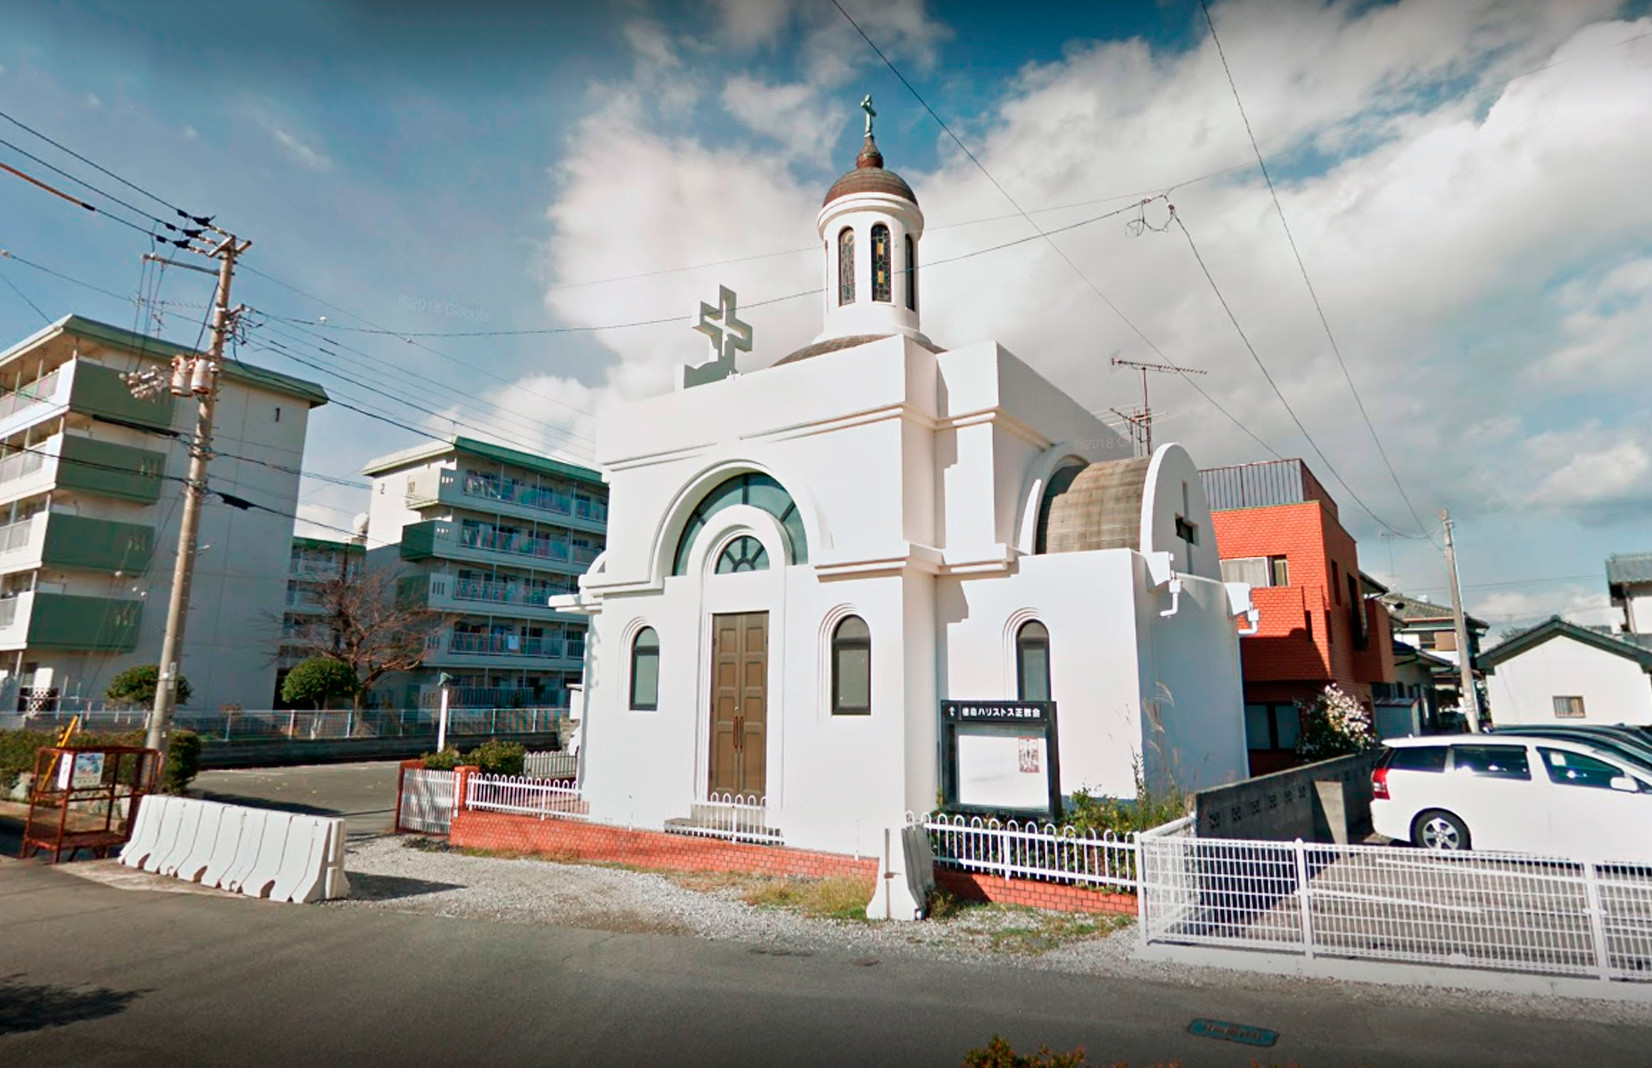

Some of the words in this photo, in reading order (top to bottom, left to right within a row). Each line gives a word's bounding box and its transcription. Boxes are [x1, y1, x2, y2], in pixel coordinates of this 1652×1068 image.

[961, 706, 1041, 718] ハリストス正教会
